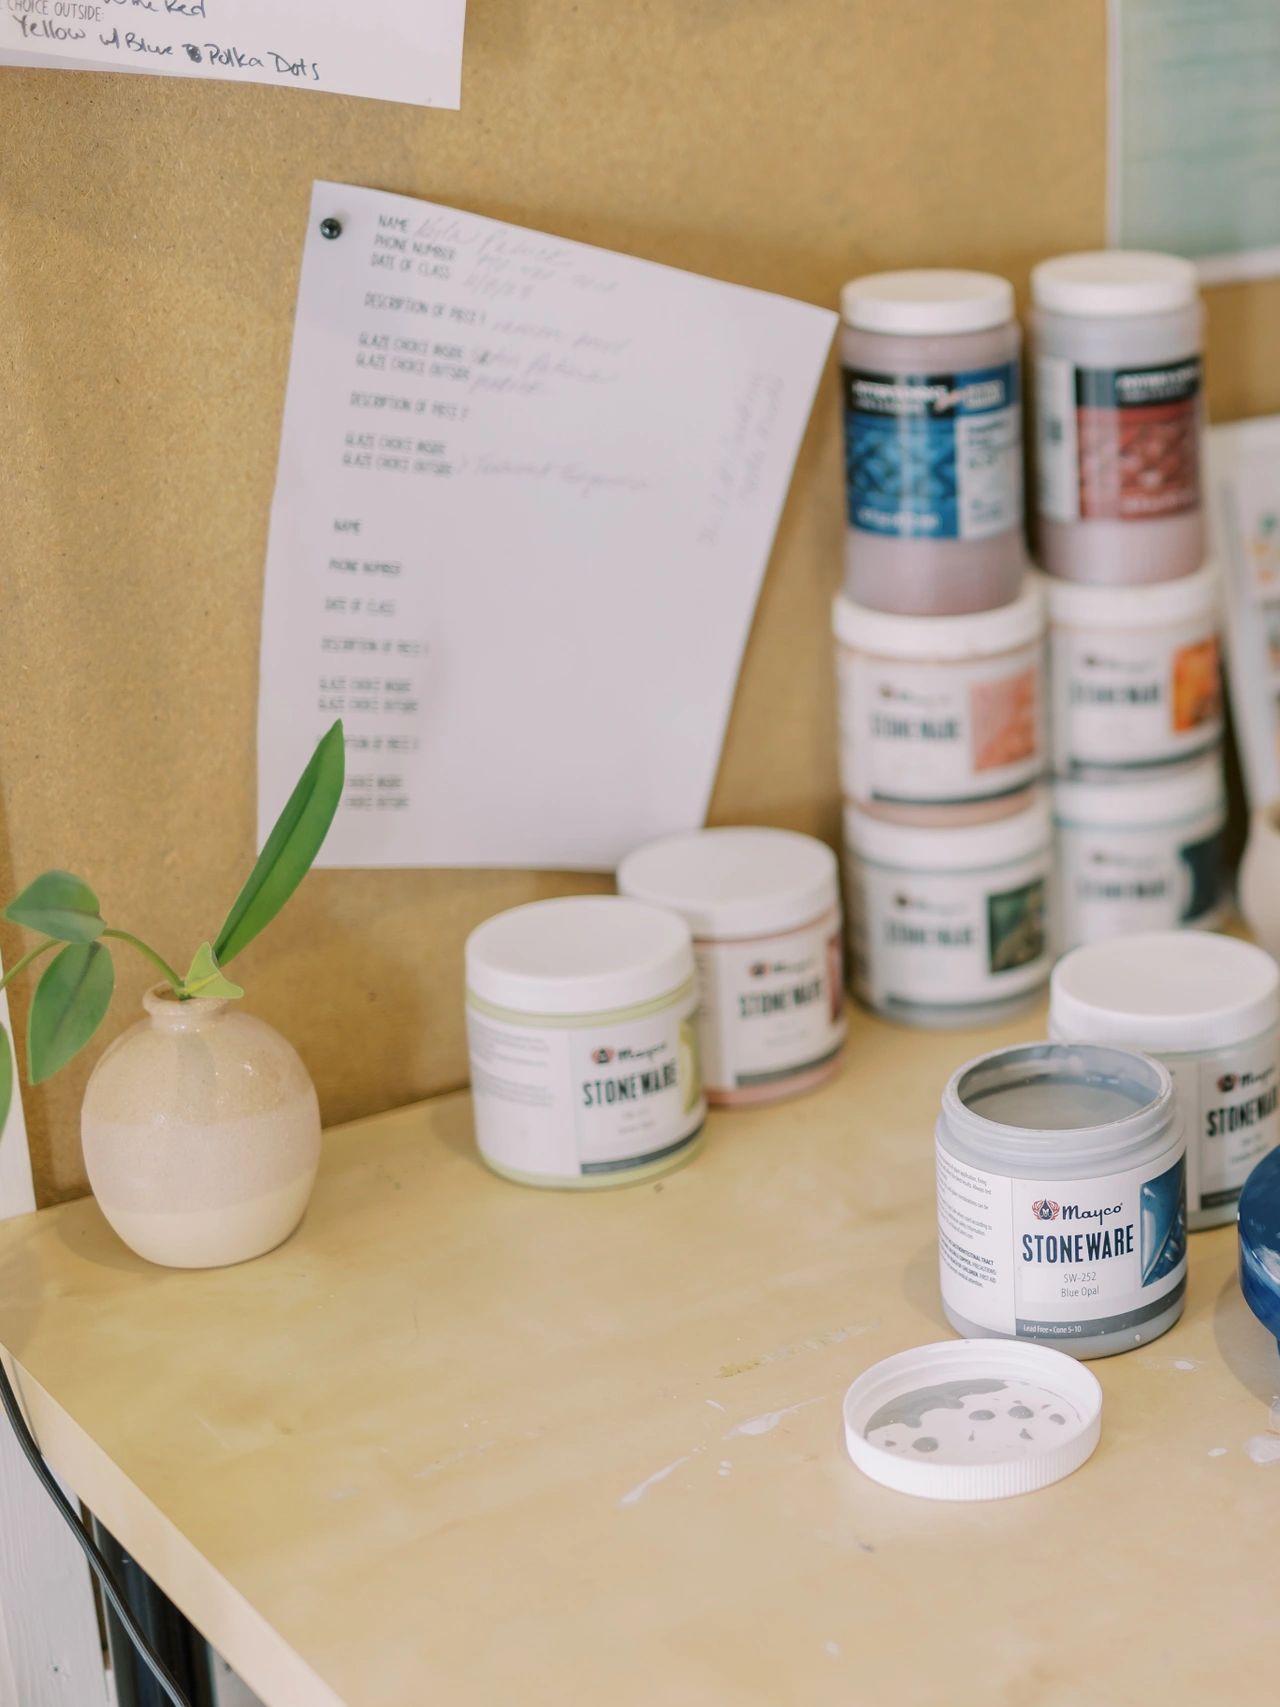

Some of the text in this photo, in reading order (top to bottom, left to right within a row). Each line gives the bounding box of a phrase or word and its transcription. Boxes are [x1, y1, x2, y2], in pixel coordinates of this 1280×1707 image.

[13, 15, 86, 40] Yellow
[125, 32, 173, 57] Blue
[204, 43, 264, 69] Polka
[267, 51, 320, 80] Dots
[583, 1059, 677, 1106] STONEWARE
[1062, 1204, 1121, 1225] Mayco
[1022, 1223, 1134, 1263] STONEWARE
[1063, 1272, 1097, 1284] SW-252
[1061, 1286, 1100, 1298] Blue Opal
[1023, 1323, 1037, 1333] Lead
[1037, 1324, 1050, 1334] Free
[1053, 1325, 1067, 1334] Cone
